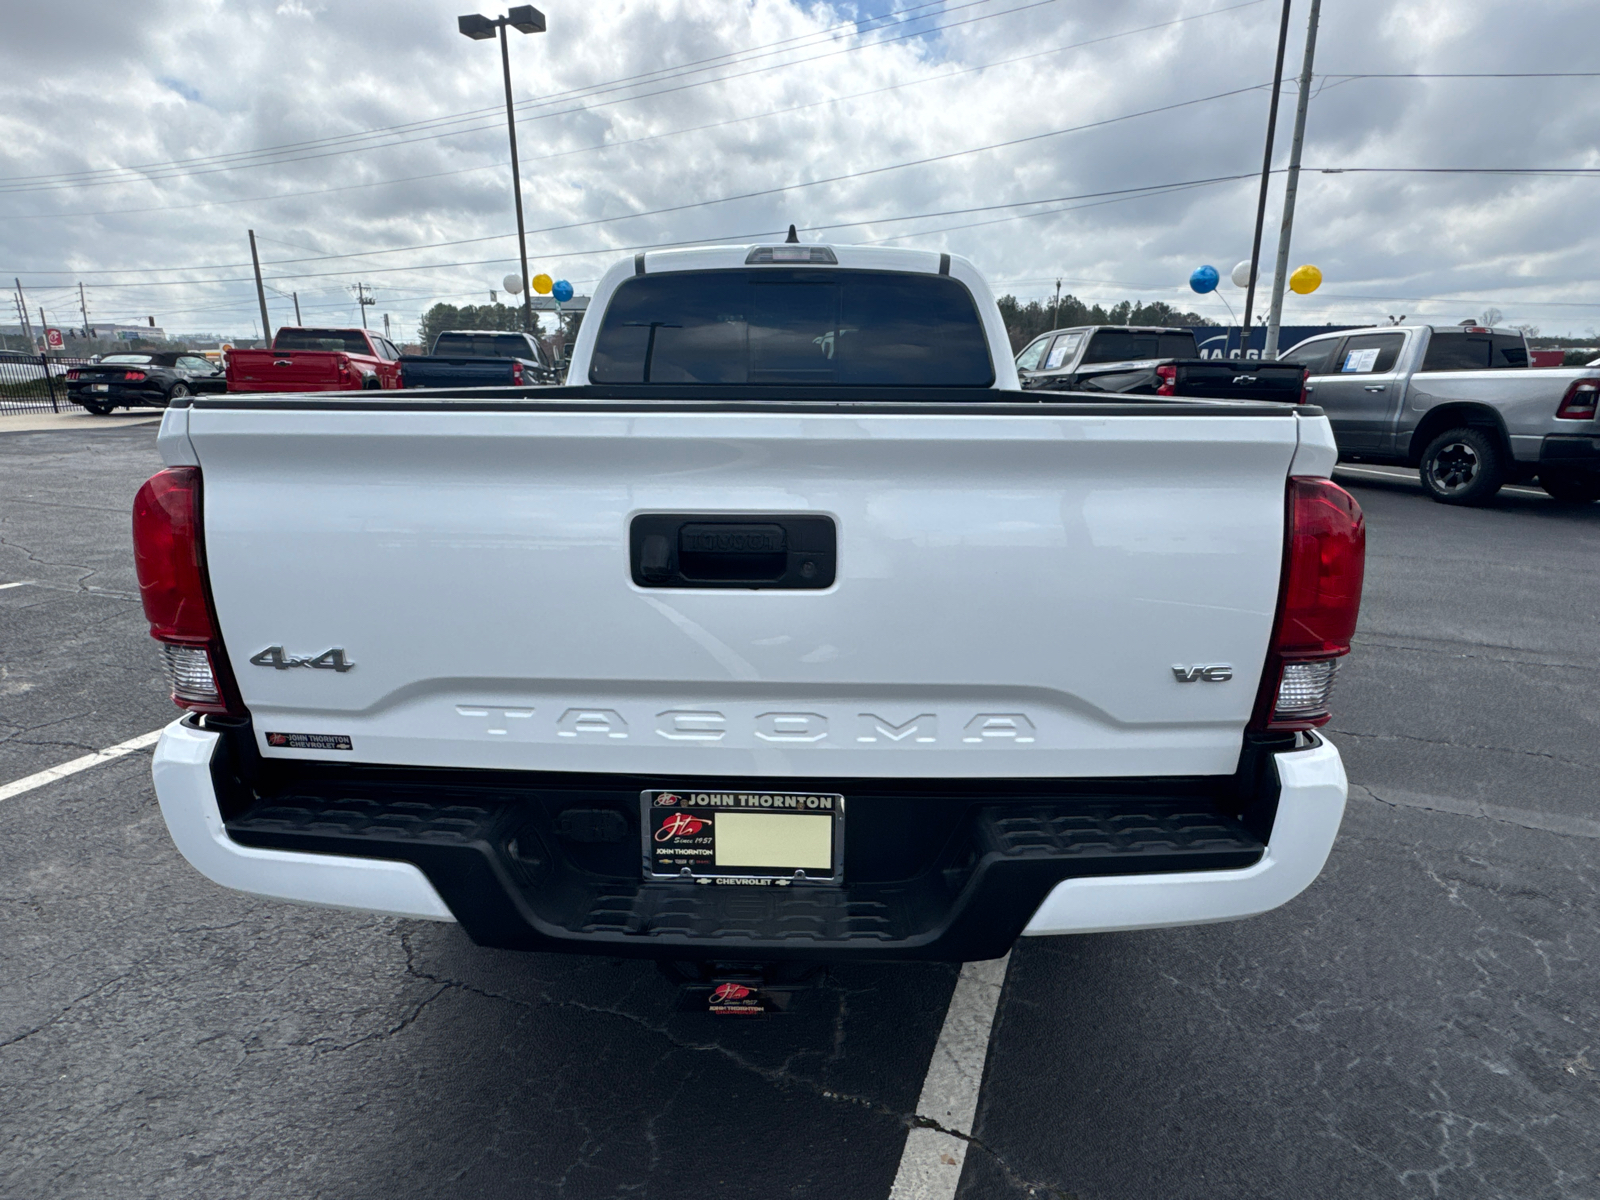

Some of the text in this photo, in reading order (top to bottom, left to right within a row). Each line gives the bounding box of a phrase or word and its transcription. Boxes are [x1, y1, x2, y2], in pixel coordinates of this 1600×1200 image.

[1171, 664, 1233, 683] V6
[455, 704, 1036, 743] TACOMA
[309, 735, 350, 743] THORNTON
[289, 740, 336, 748] CHEVROLET
[688, 794, 832, 809] JOHN THORNTON
[673, 836, 713, 844] Since 1957
[716, 878, 772, 886] CHEVROLET
